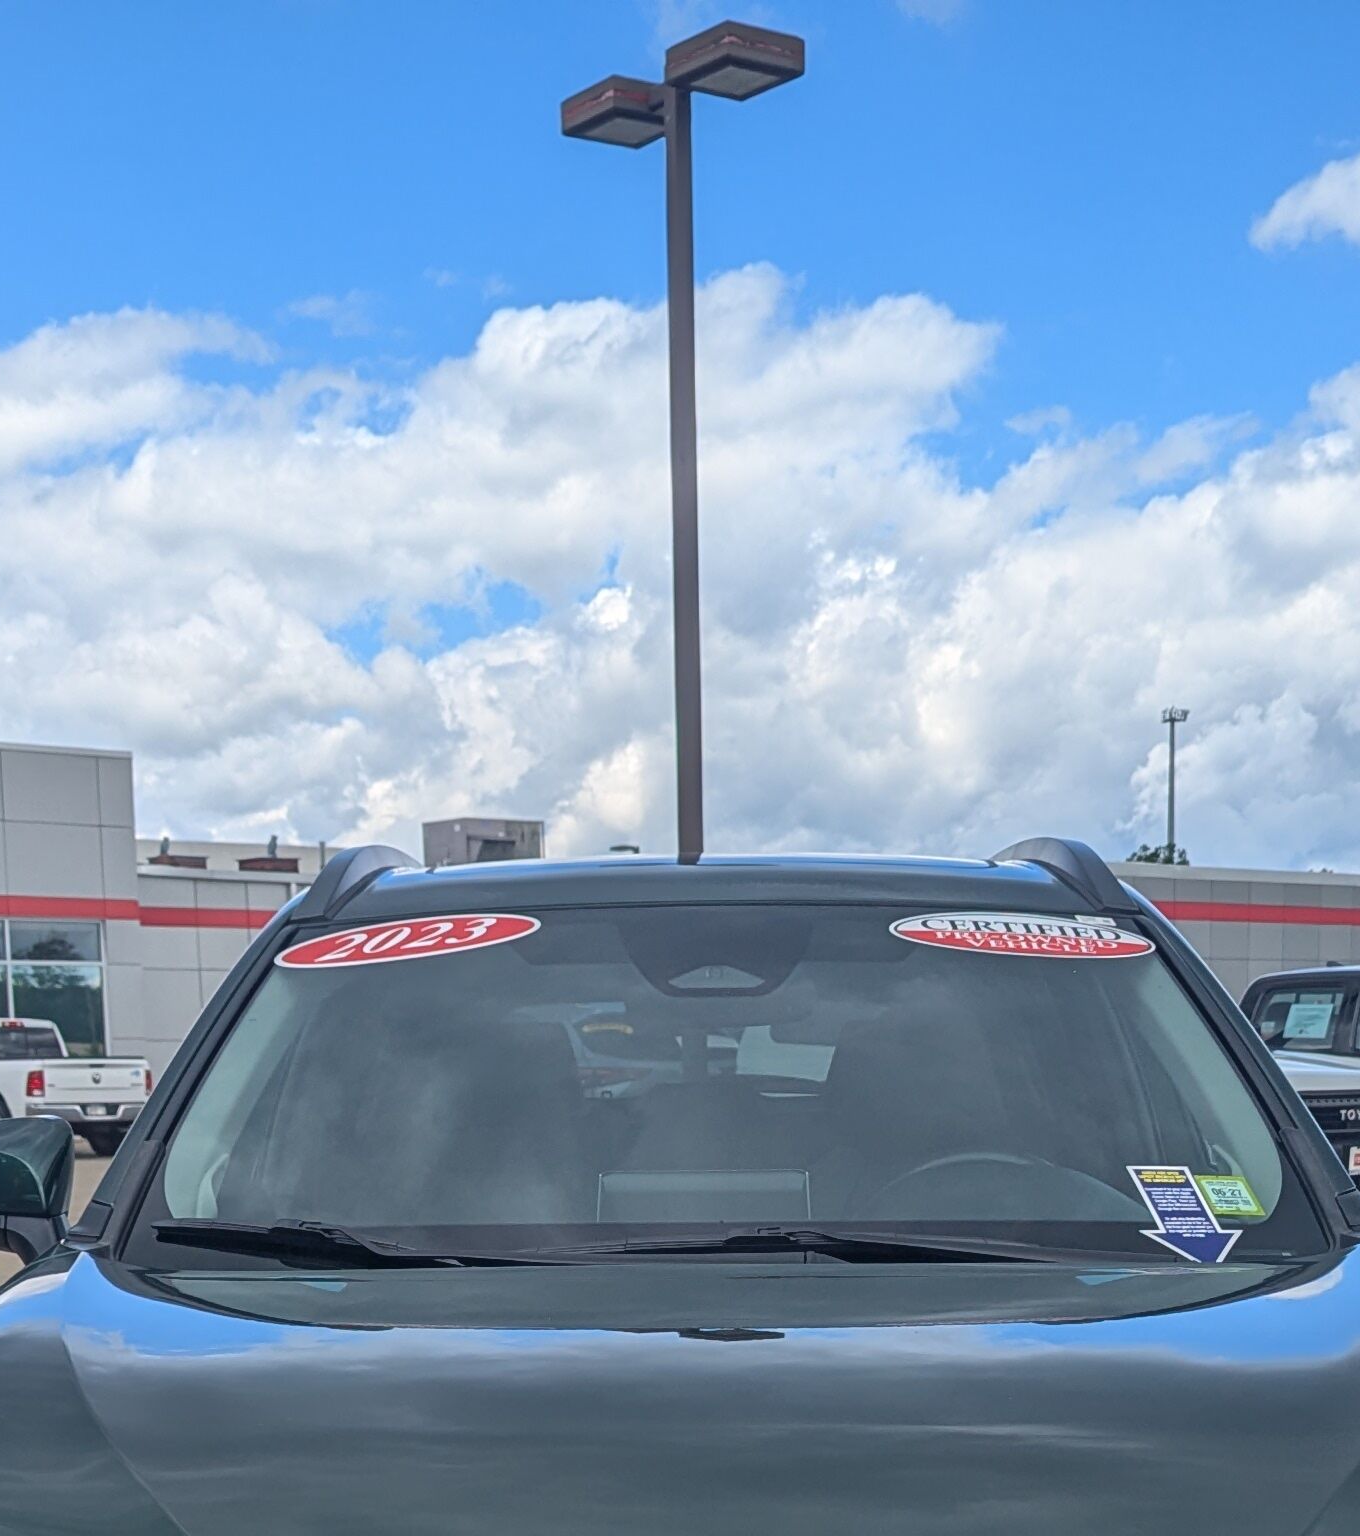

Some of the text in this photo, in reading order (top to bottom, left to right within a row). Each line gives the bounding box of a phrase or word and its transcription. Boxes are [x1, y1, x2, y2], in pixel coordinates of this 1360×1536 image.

[314, 917, 498, 963] 2023
[920, 918, 1122, 941] CERTIFIED
[934, 930, 1119, 949] PRE-OWNED
[965, 937, 1097, 954] VEHICLE
